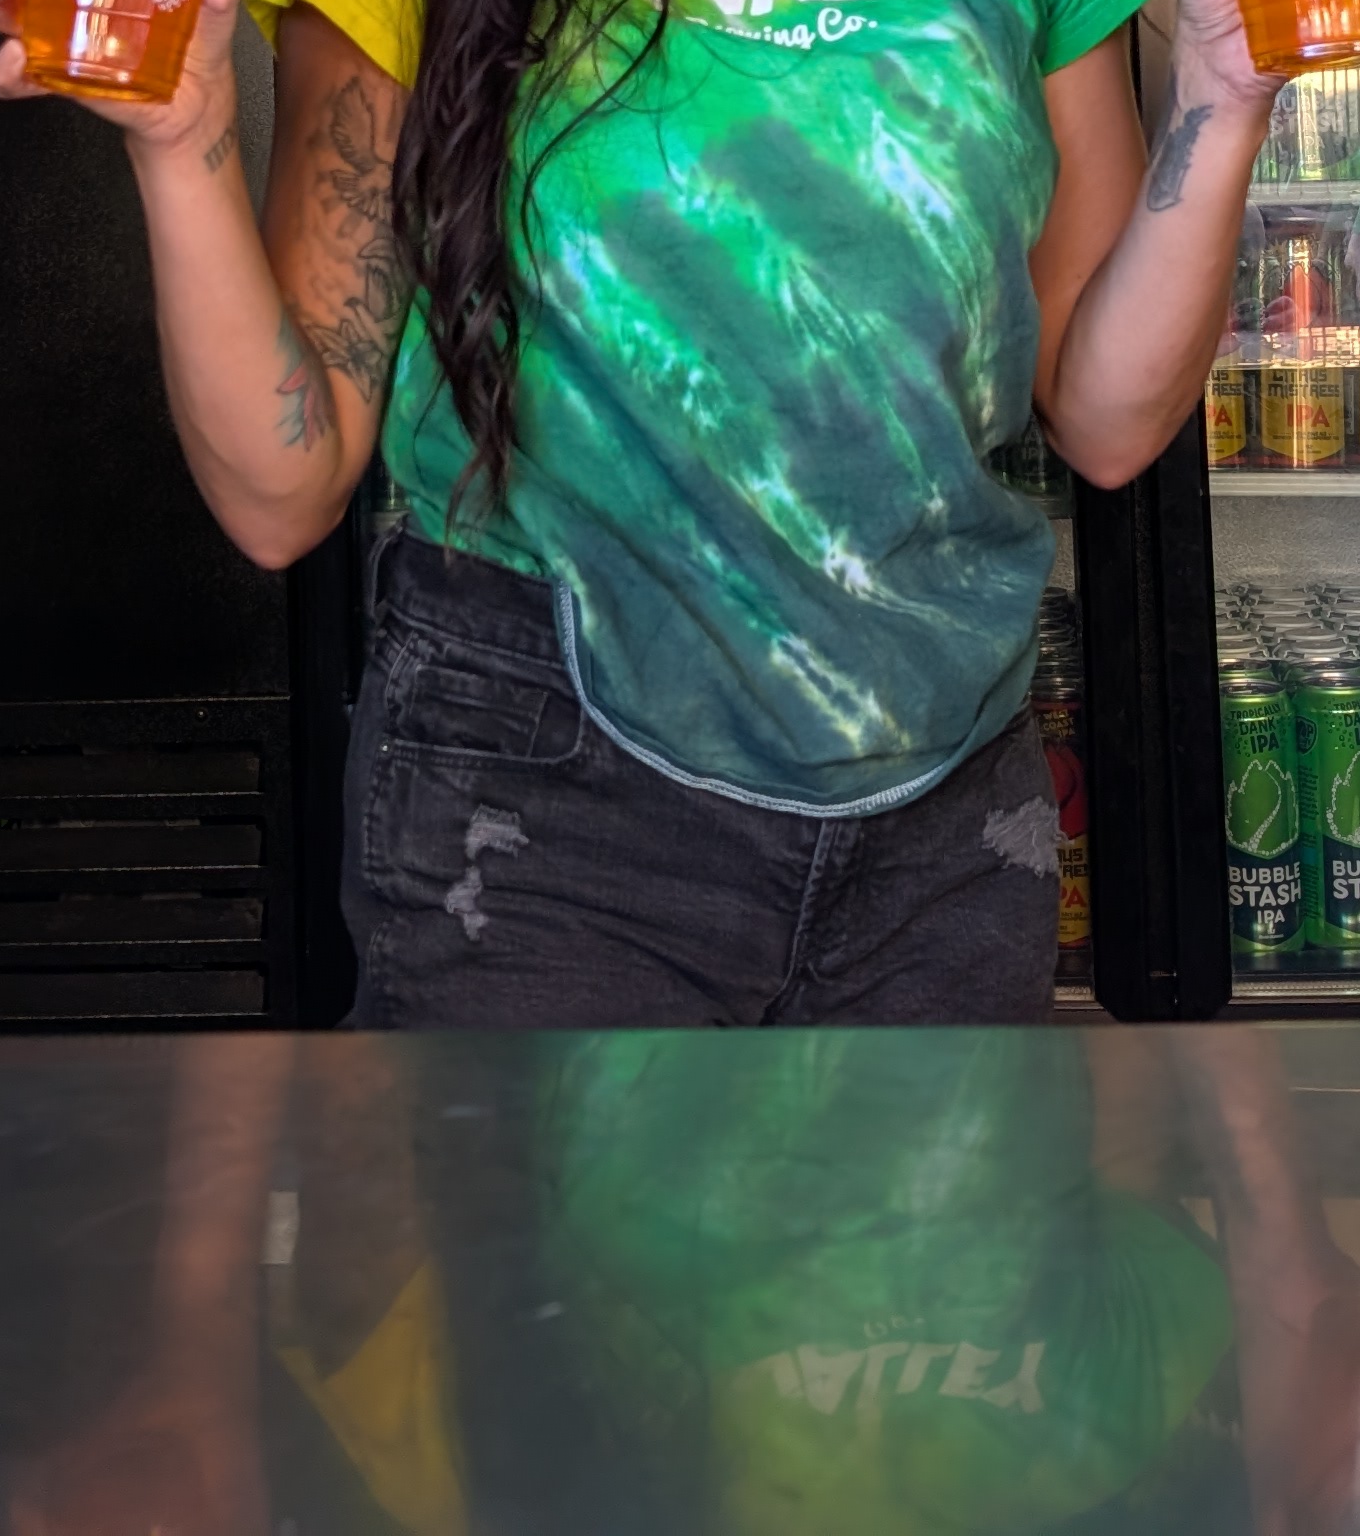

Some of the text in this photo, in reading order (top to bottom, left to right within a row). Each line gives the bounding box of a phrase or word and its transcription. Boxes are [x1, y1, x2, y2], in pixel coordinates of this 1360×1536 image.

[818, 7, 877, 42] Co.
[1287, 404, 1330, 428] IPA
[1230, 703, 1281, 721] TROPICALLY
[1043, 718, 1074, 731] COAST
[1239, 717, 1276, 735] DANK
[1250, 732, 1280, 754] IPA
[1228, 861, 1301, 884] BUBBLE
[1229, 879, 1302, 908] STASH
[1257, 909, 1285, 924] IPA
